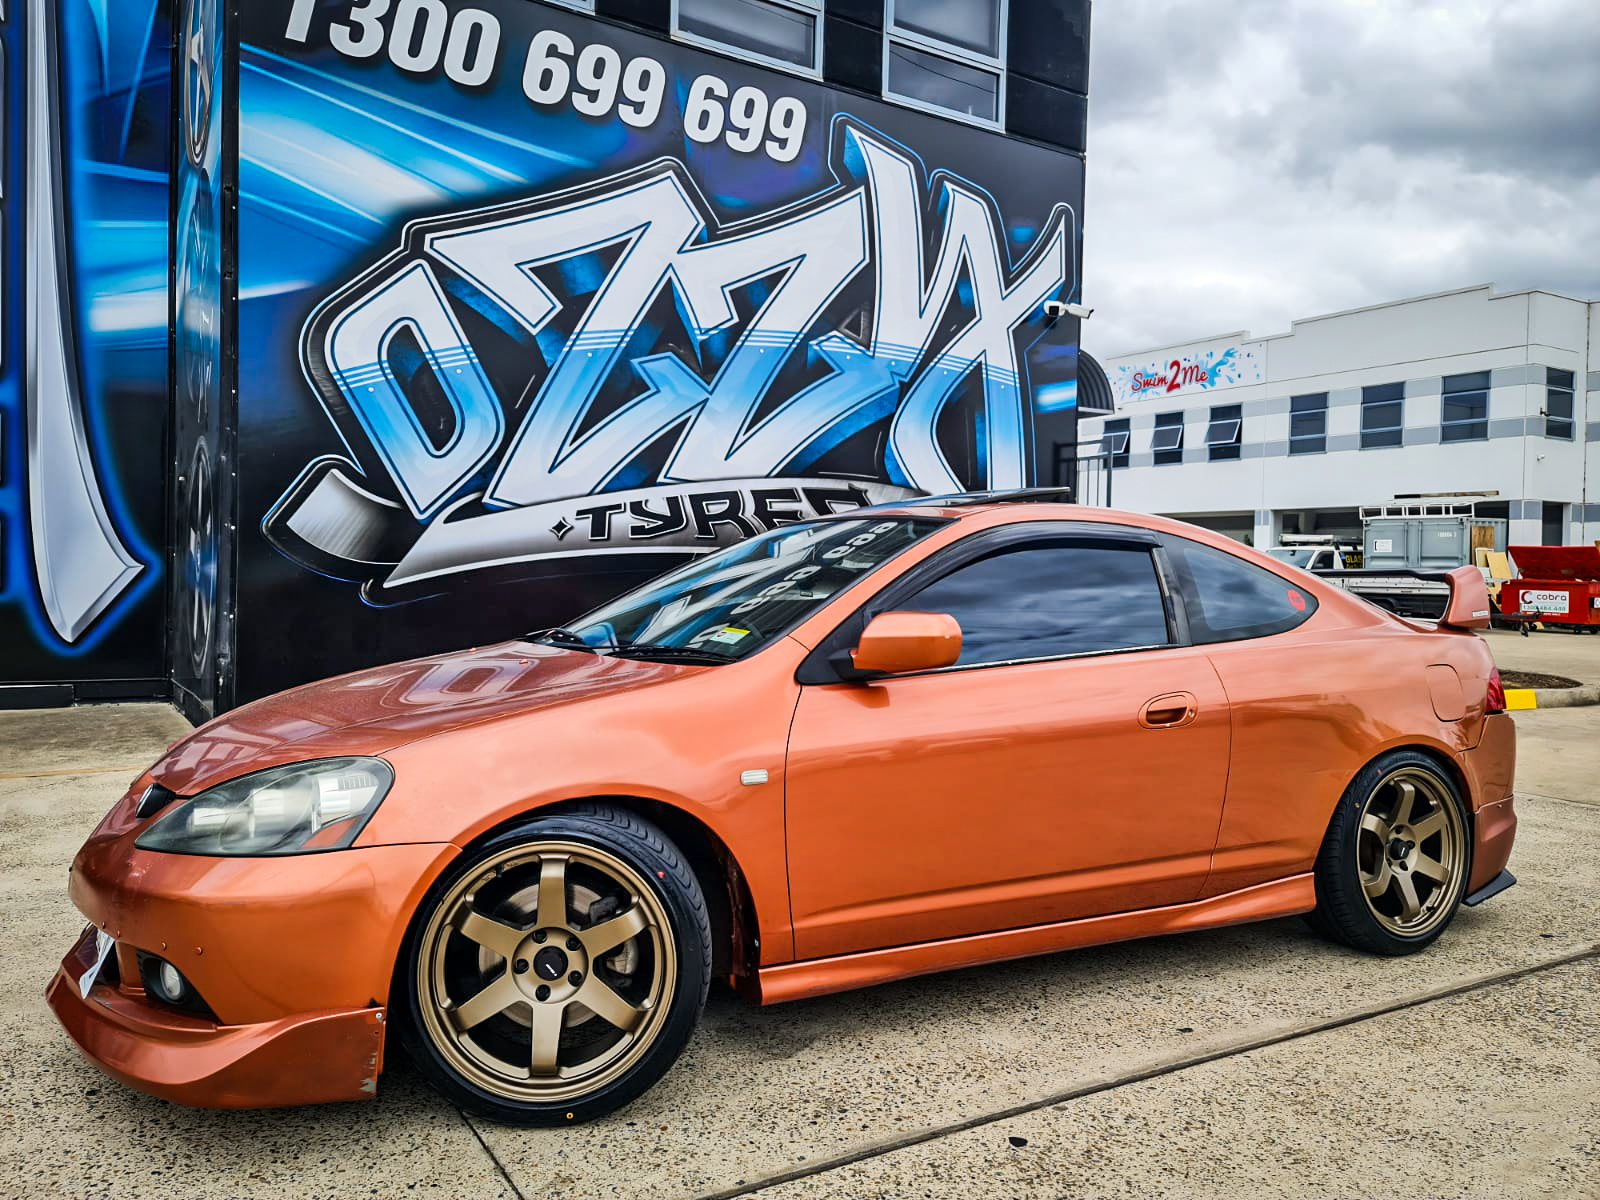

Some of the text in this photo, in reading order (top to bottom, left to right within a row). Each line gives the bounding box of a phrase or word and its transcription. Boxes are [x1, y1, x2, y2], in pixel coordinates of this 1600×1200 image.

[285, 0, 807, 162] 1300 699 699
[1536, 593, 1567, 601] cobra
